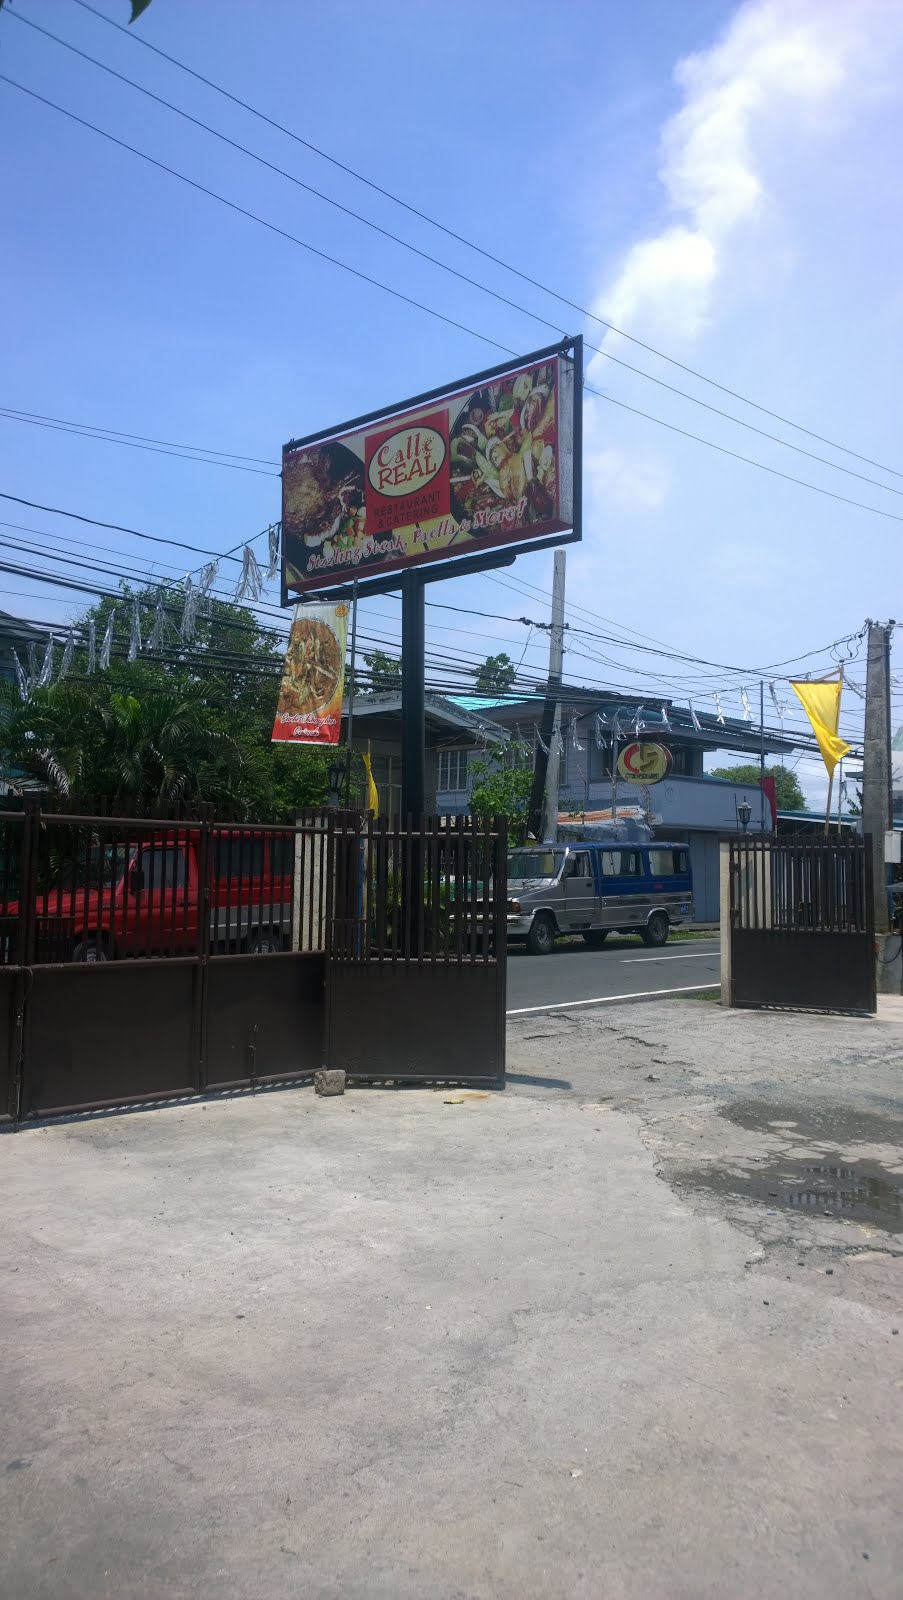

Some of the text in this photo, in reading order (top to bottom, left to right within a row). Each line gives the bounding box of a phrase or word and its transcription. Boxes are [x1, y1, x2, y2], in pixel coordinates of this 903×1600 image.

[377, 432, 435, 467] Calle
[377, 454, 437, 489] REAL
[373, 491, 441, 517] RESTAURANT
[385, 504, 439, 526] CATERING
[307, 548, 361, 572] Sizzling
[364, 534, 408, 557] Steak,
[413, 519, 456, 544] Paella
[460, 519, 471, 532] &
